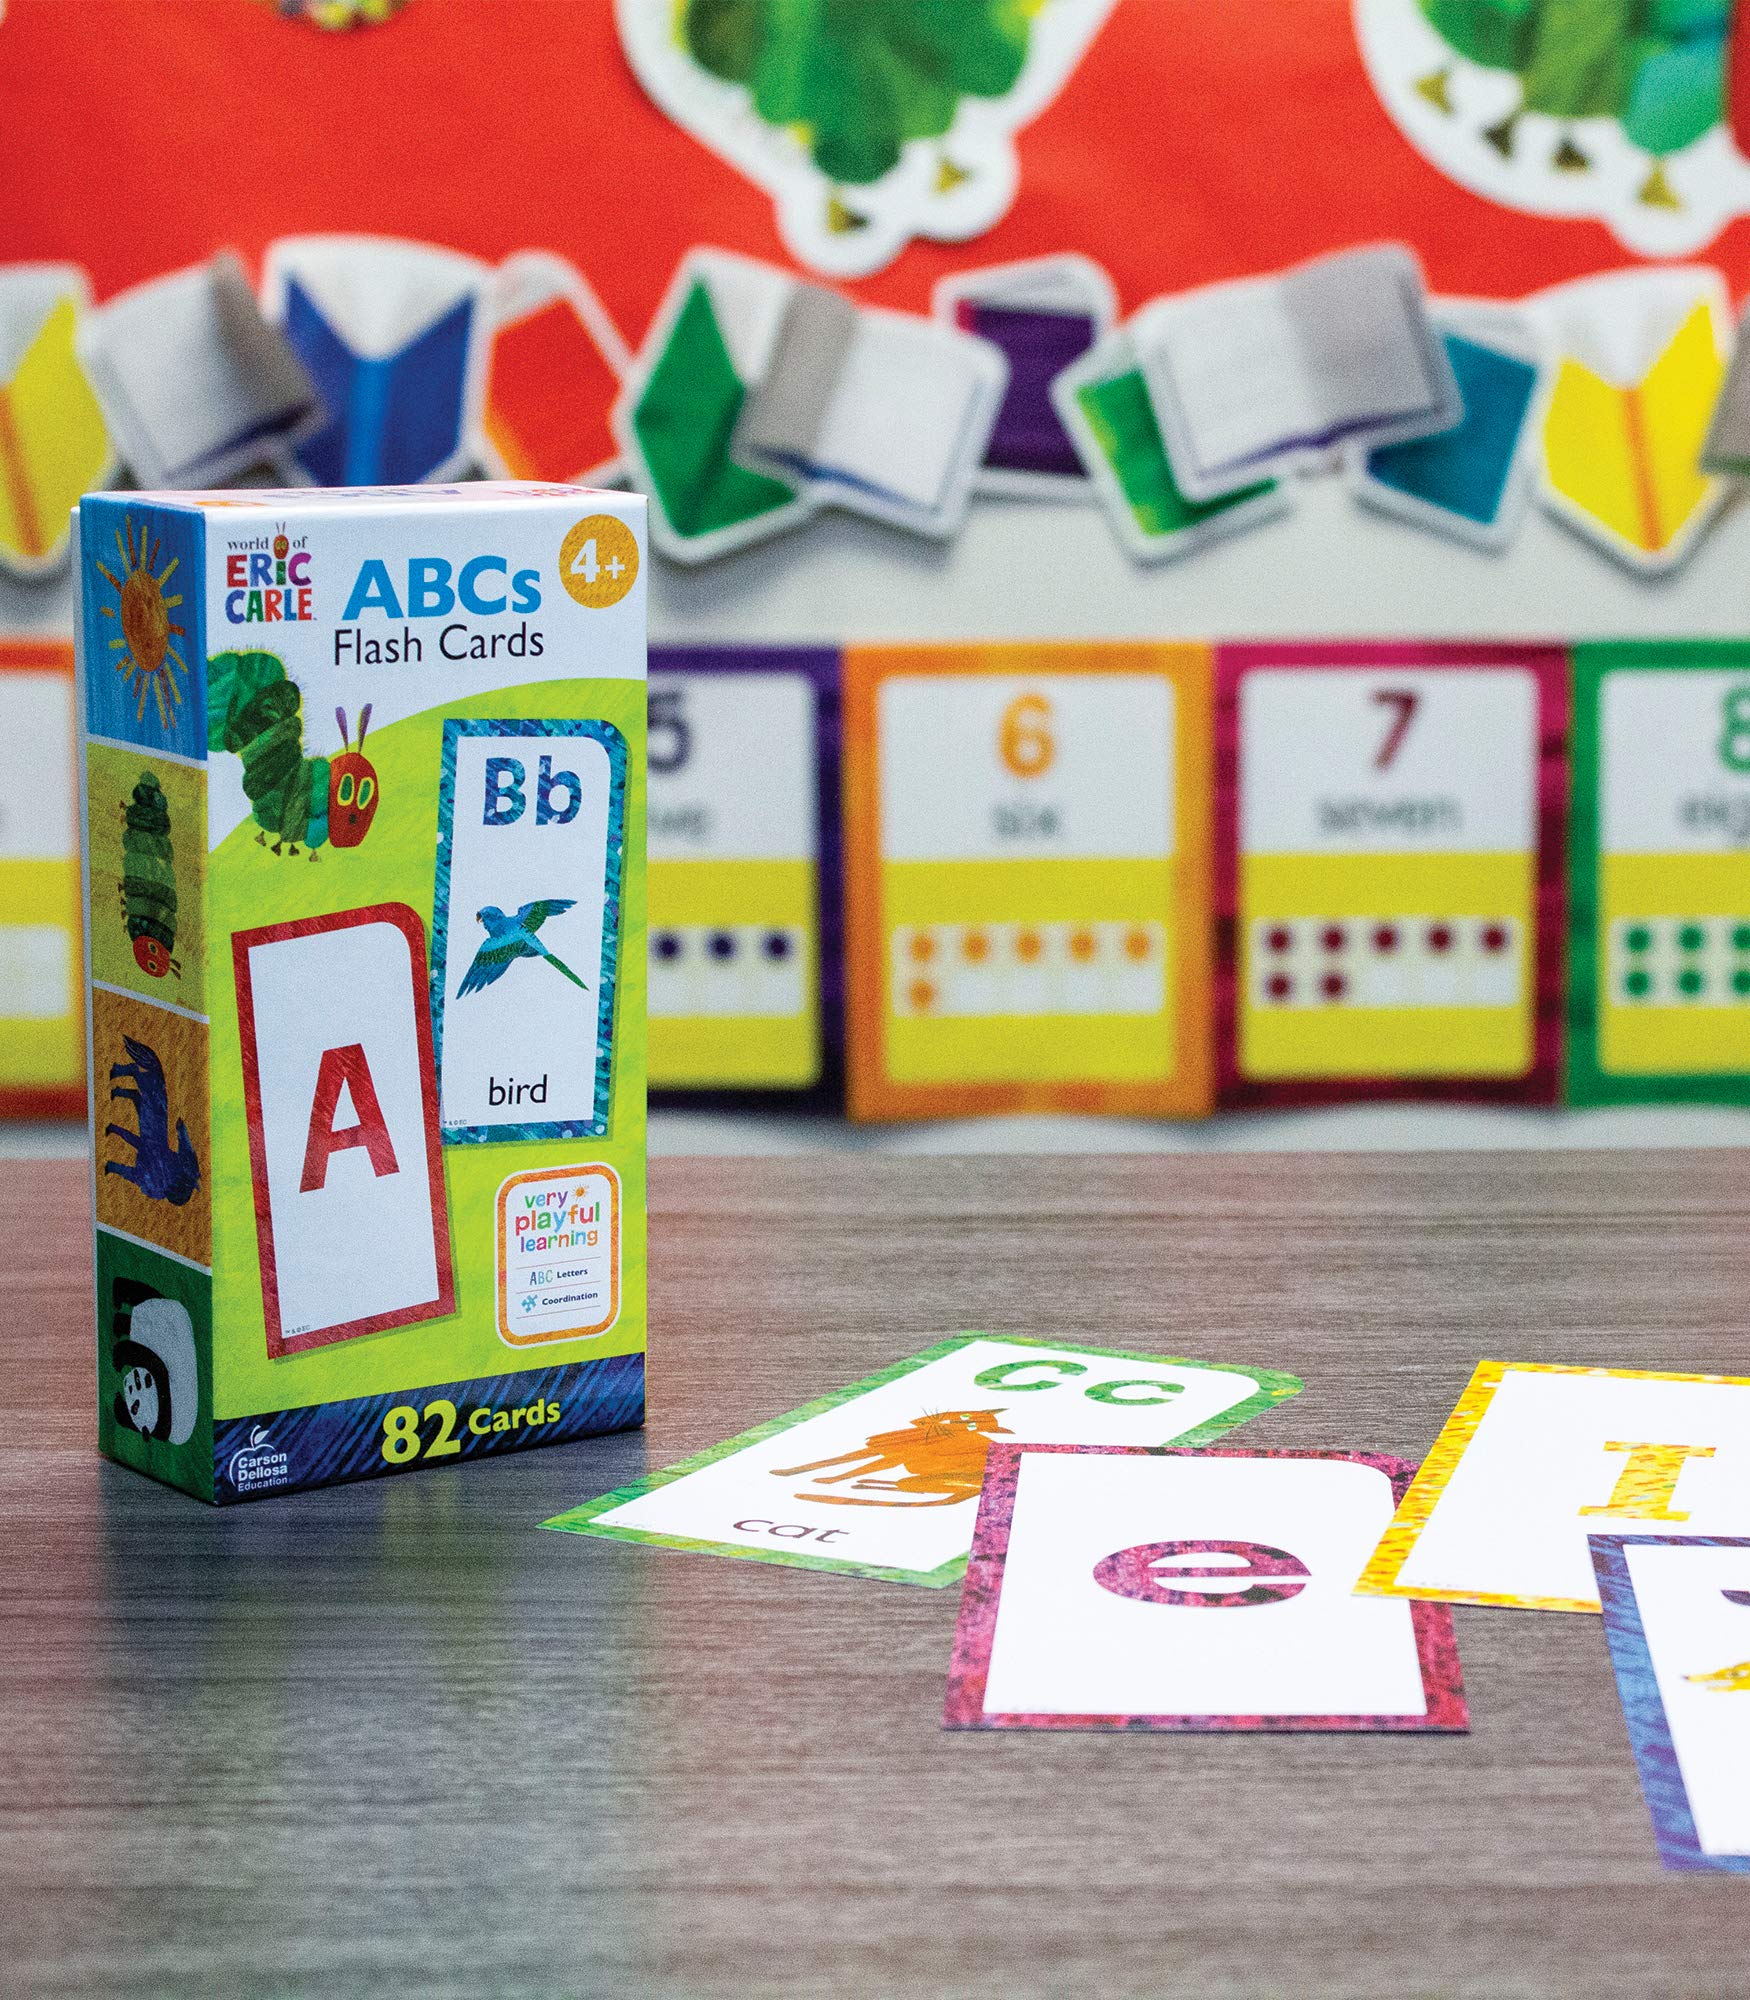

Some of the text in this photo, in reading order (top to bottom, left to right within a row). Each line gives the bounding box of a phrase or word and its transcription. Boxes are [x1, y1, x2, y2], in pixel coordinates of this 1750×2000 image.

[227, 535, 309, 550] world of
[570, 538, 625, 584] 4+
[341, 555, 542, 620] ABCs
[225, 588, 313, 624] CARLE
[334, 621, 544, 665] Flash Cards
[997, 693, 1056, 781] 6
[1368, 687, 1424, 774] 7
[483, 755, 582, 826] Bb
[488, 1074, 548, 1106] bird
[300, 1043, 400, 1193] A
[524, 1190, 568, 1208] very
[515, 1202, 600, 1236] playful
[520, 1230, 598, 1252] learning
[530, 1269, 588, 1285] ABC Letters
[542, 1292, 598, 1305] Coordination
[973, 1359, 1186, 1406] Cc
[381, 1398, 561, 1464] 82 Cards
[238, 1453, 287, 1469] Carson
[238, 1464, 288, 1481] Dellosa
[238, 1476, 288, 1492] Education
[1577, 1440, 1717, 1522] I
[733, 1518, 850, 1544] cat
[1093, 1539, 1312, 1607] e
